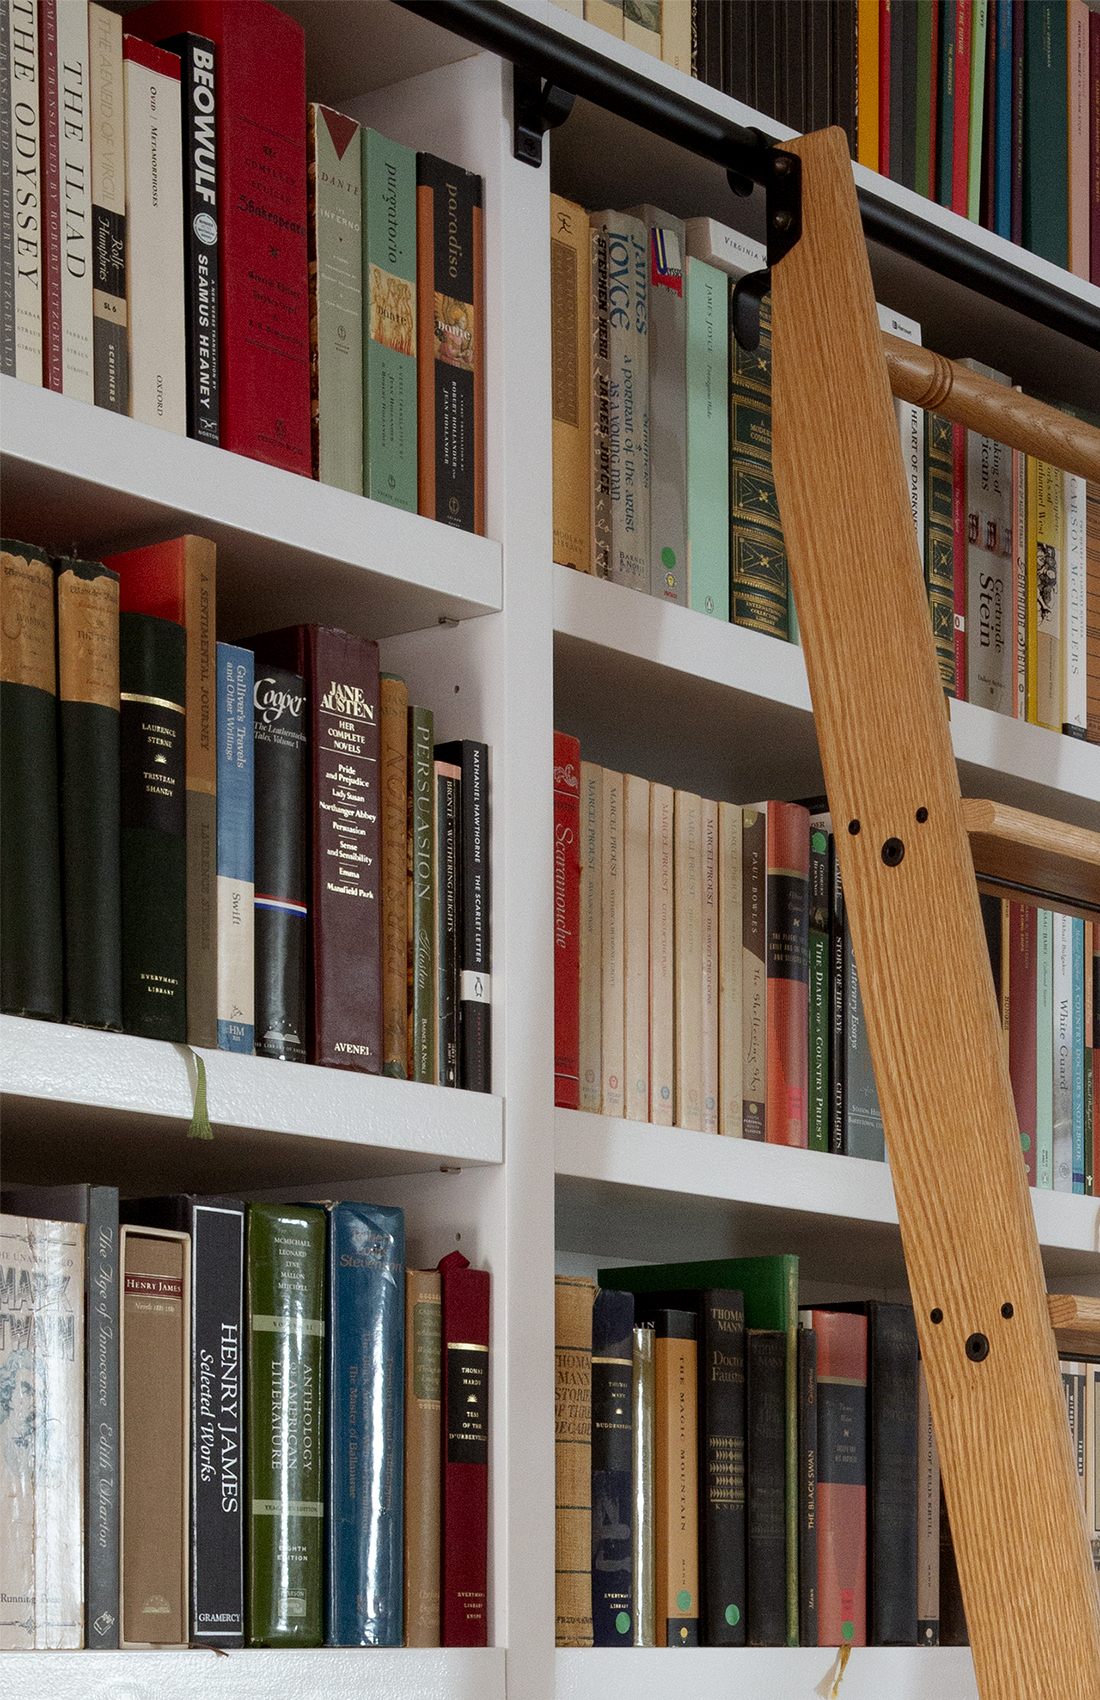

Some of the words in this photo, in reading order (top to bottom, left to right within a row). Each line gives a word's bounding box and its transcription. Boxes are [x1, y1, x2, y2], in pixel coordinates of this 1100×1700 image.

[13, 1, 35, 82] THE
[63, 60, 83, 142] THE
[192, 46, 215, 205] BEOWULF
[15, 102, 38, 289] ODYSSEY
[322, 172, 359, 196] DANTE
[64, 158, 86, 279] ILIAD
[321, 208, 359, 232] INFERNO
[197, 253, 209, 331] SEAMUS
[199, 335, 210, 408] HEANEY
[911, 454, 917, 466] OF
[979, 572, 994, 649] Stein
[253, 676, 306, 719] Cooper
[319, 694, 375, 720] AUSTEN
[329, 681, 364, 704] JANE
[328, 728, 366, 745] COMPLETE
[333, 741, 361, 754] NOVELS
[339, 720, 356, 732] HER
[338, 764, 357, 775] Pride
[416, 726, 430, 901] PERSUASION
[338, 868, 360, 879] Emma
[555, 823, 574, 949] Scaramouche
[231, 892, 240, 926] Swift
[126, 1279, 156, 1290] HENRY
[158, 1281, 182, 1293] JAMES
[200, 1349, 213, 1422] Selected
[221, 1322, 237, 1418] HENRY
[303, 1364, 312, 1471] ANTHOLOGY
[201, 1426, 211, 1483] Works
[219, 1422, 238, 1513] JAMES
[198, 1613, 241, 1623] GRAMERCY
